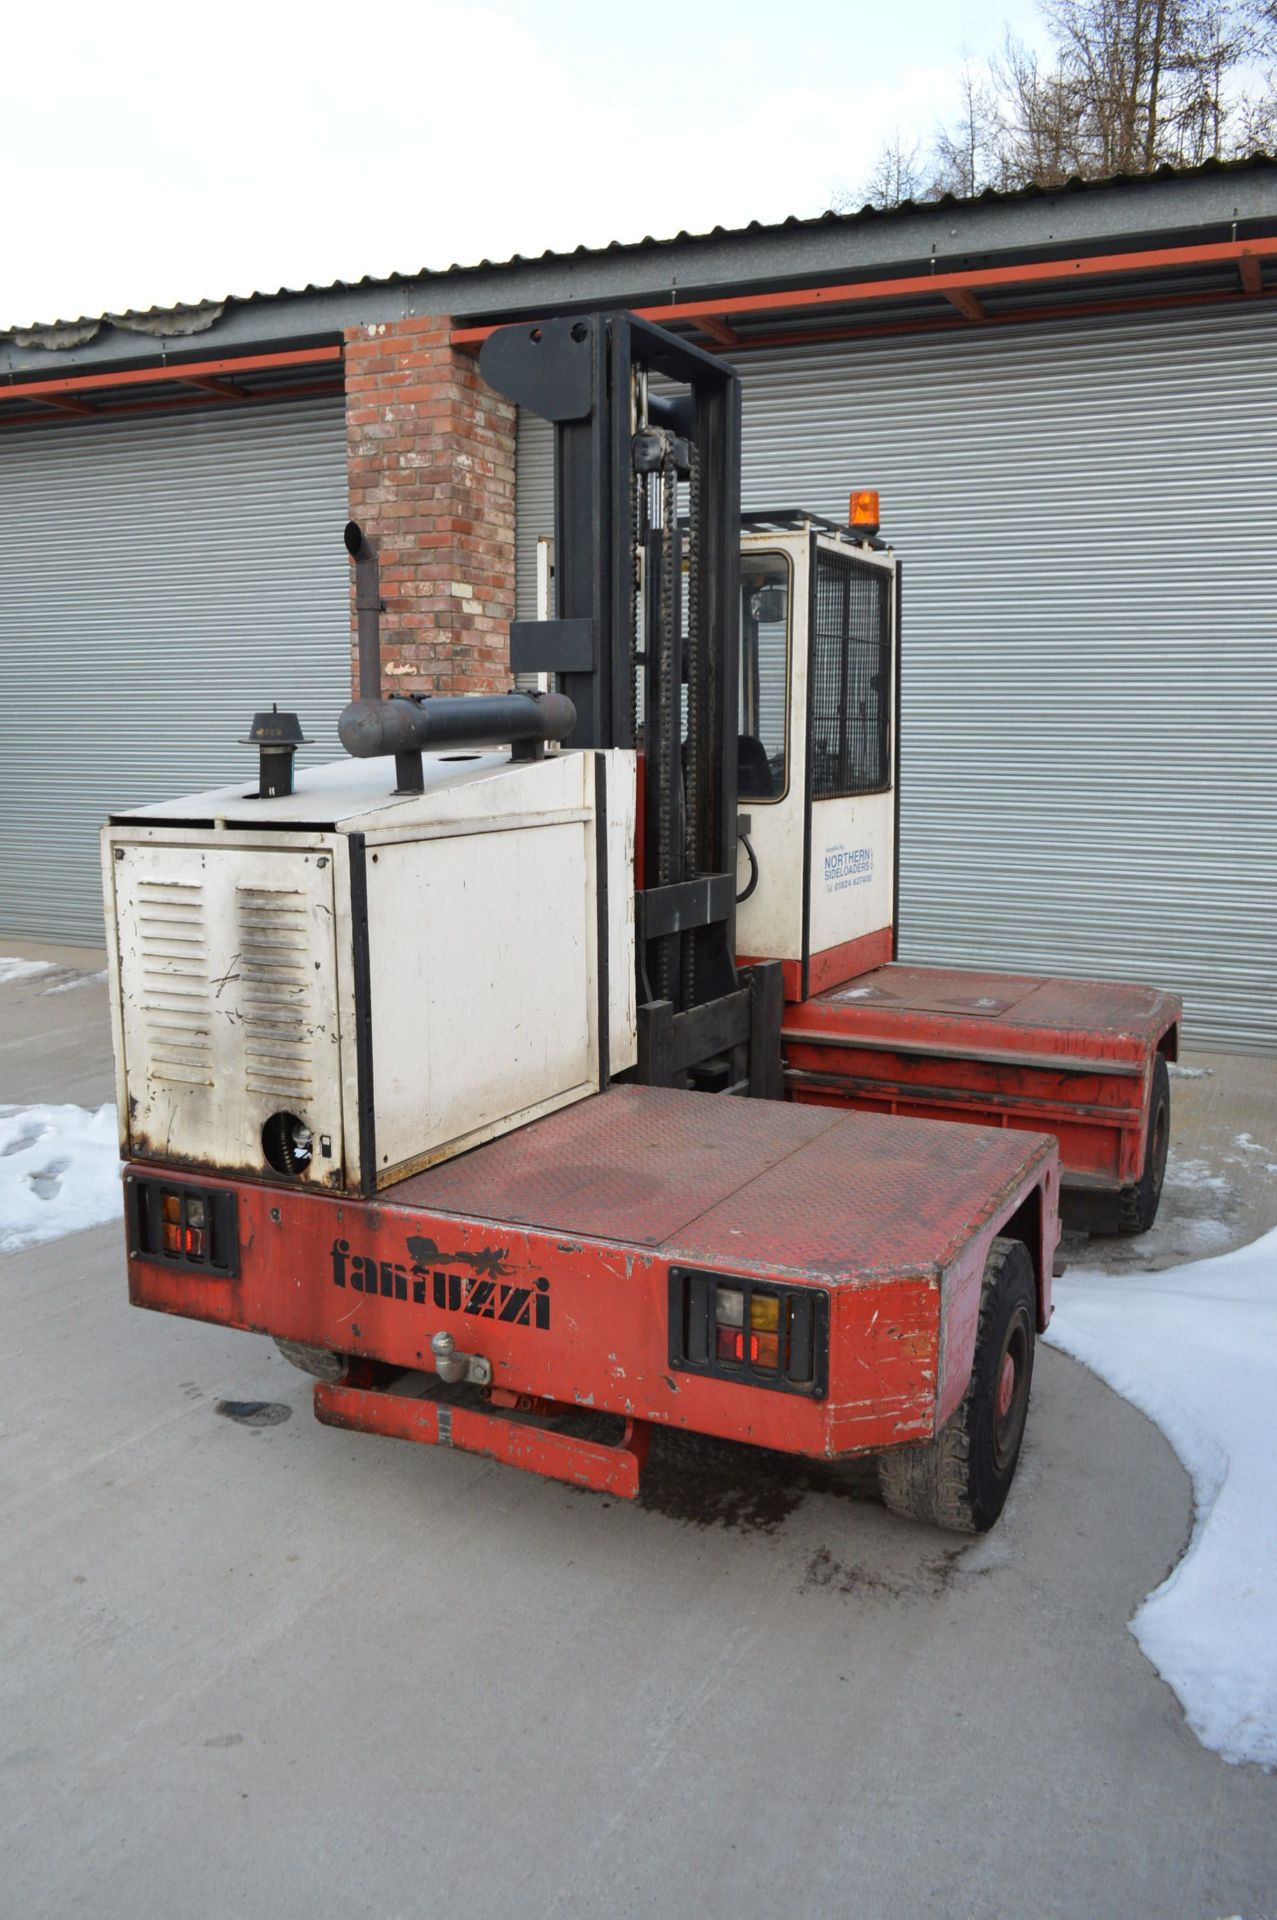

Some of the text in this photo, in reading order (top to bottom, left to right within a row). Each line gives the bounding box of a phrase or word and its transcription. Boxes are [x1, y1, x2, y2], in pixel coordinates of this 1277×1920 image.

[824, 847, 870, 869] NORTHERN
[824, 860, 870, 881] SIDELOADERS
[330, 1238, 550, 1331] fantuzzi
